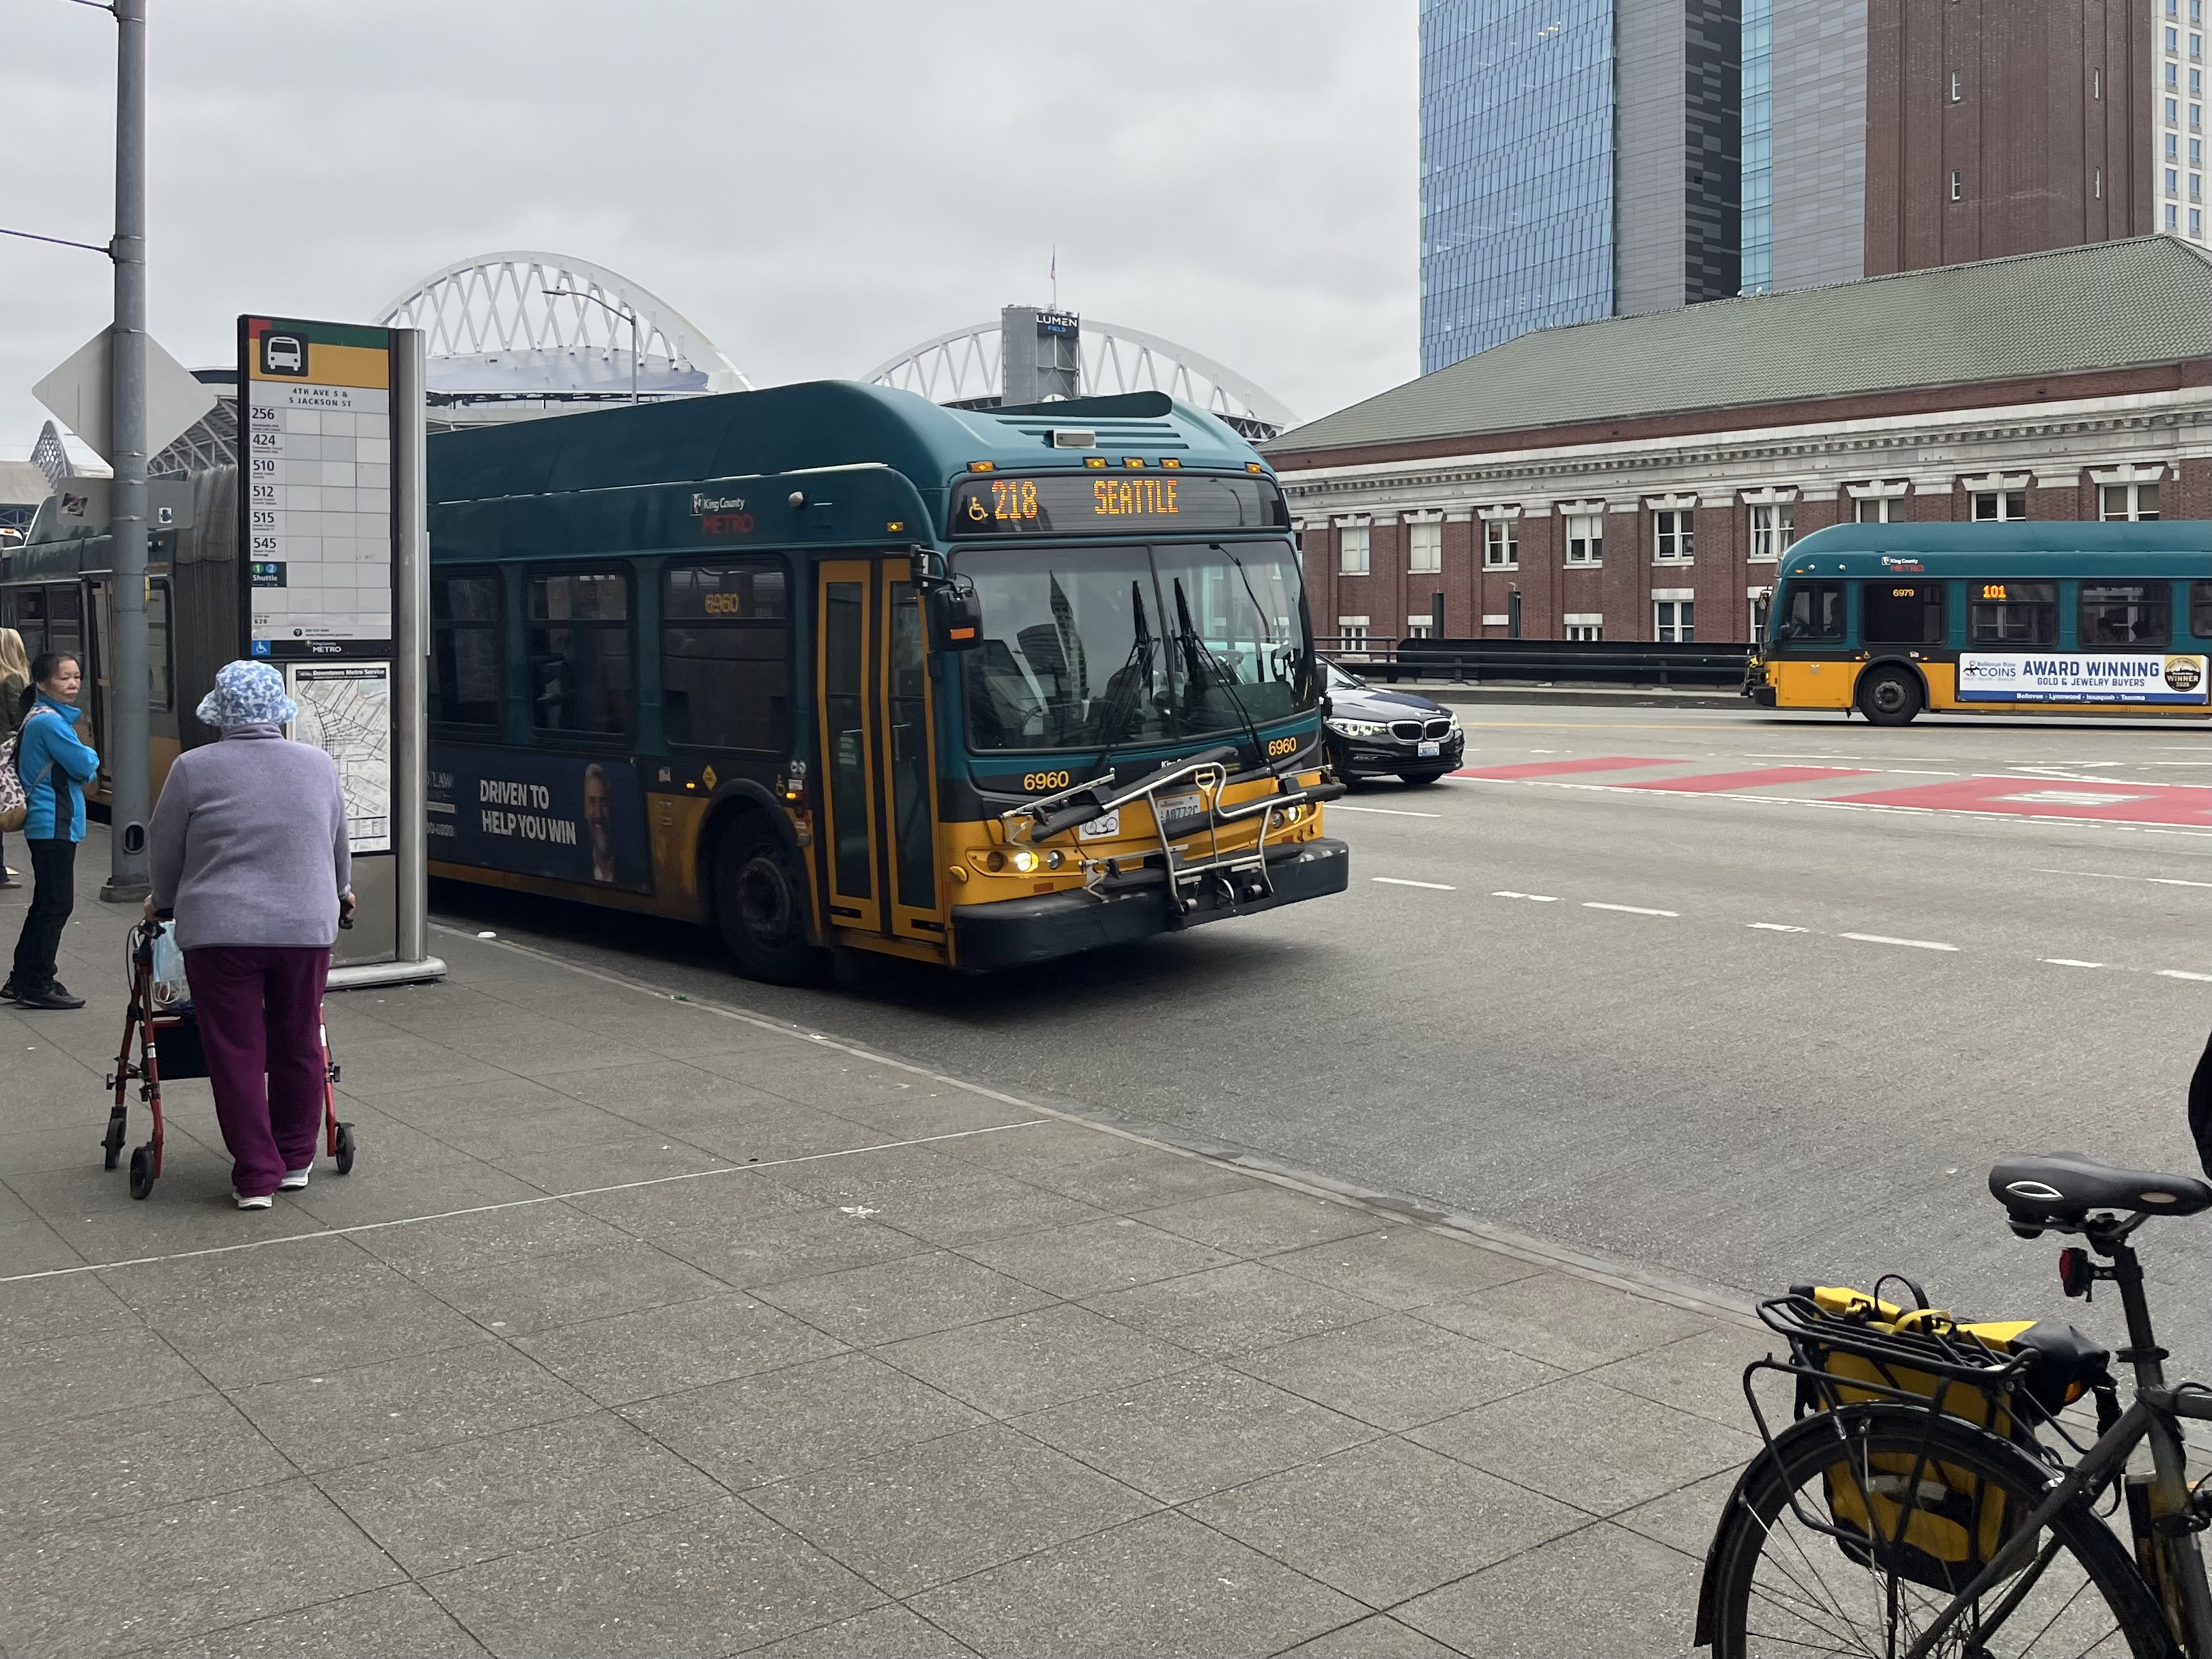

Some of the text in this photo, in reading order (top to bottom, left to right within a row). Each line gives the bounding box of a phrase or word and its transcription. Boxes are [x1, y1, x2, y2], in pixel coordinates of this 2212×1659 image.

[1037, 315, 1078, 328] LUMEN
[1048, 325, 1067, 333] FIELD
[298, 398, 339, 406] JACKSON
[252, 407, 274, 420] 256
[253, 434, 276, 446] 424
[253, 460, 274, 471] 510
[253, 486, 274, 497] 512
[703, 497, 745, 512] King County
[991, 480, 1179, 519] 218 SEATTLE
[253, 512, 274, 523] 515
[254, 538, 276, 549] 545
[1893, 589, 1914, 597] 6979
[1983, 585, 2007, 599] 101
[706, 594, 739, 614] 6960
[1979, 667, 2016, 677] COINS
[2023, 661, 2080, 676] AWARD
[2086, 661, 2159, 677] WINNING
[2112, 678, 2144, 687] BUYERS
[1268, 737, 1297, 756] 6960
[1023, 770, 1069, 791] 6960
[480, 779, 527, 807] DRIVEN
[530, 785, 549, 809] TO
[482, 809, 516, 835] HELP
[517, 813, 547, 841] YOU
[547, 818, 577, 846] WIN
